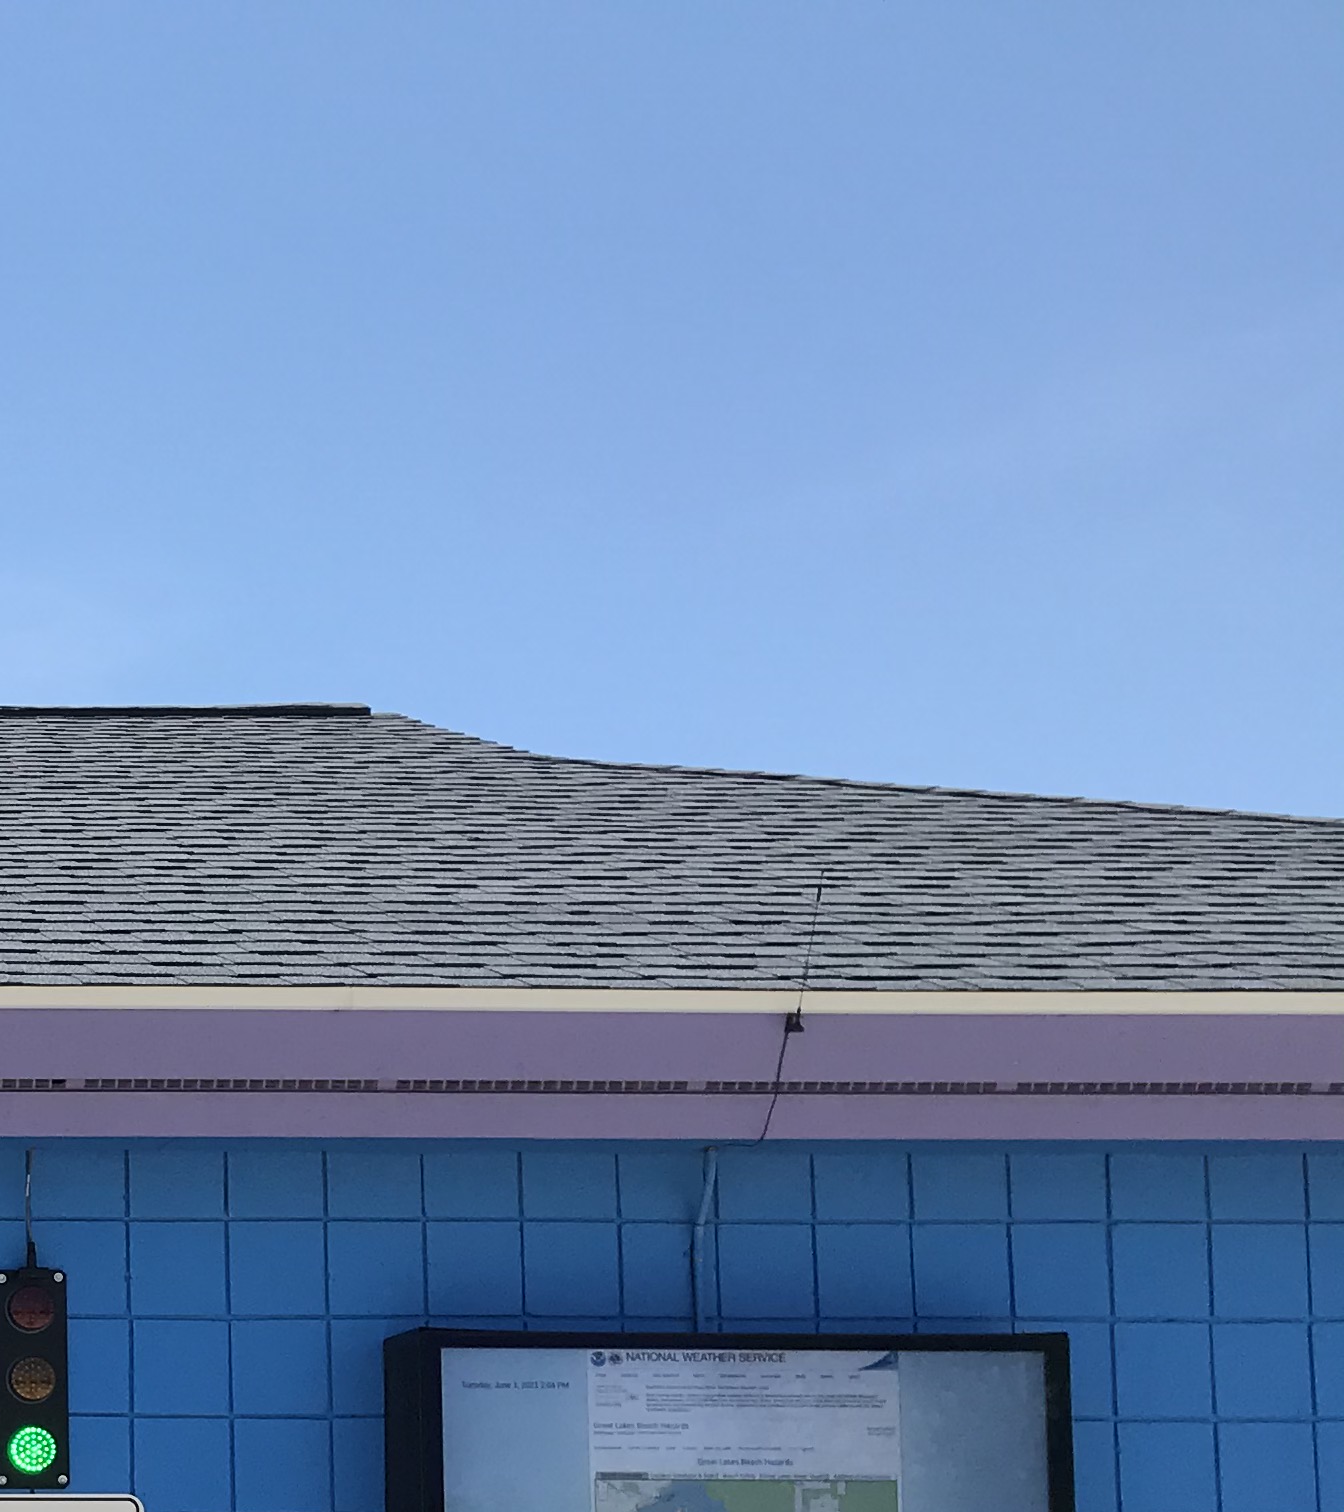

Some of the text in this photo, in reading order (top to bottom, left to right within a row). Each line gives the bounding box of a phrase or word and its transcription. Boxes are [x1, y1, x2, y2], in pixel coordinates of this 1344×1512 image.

[626, 1351, 787, 1364] NATIONAL WEATHER SERVICE
